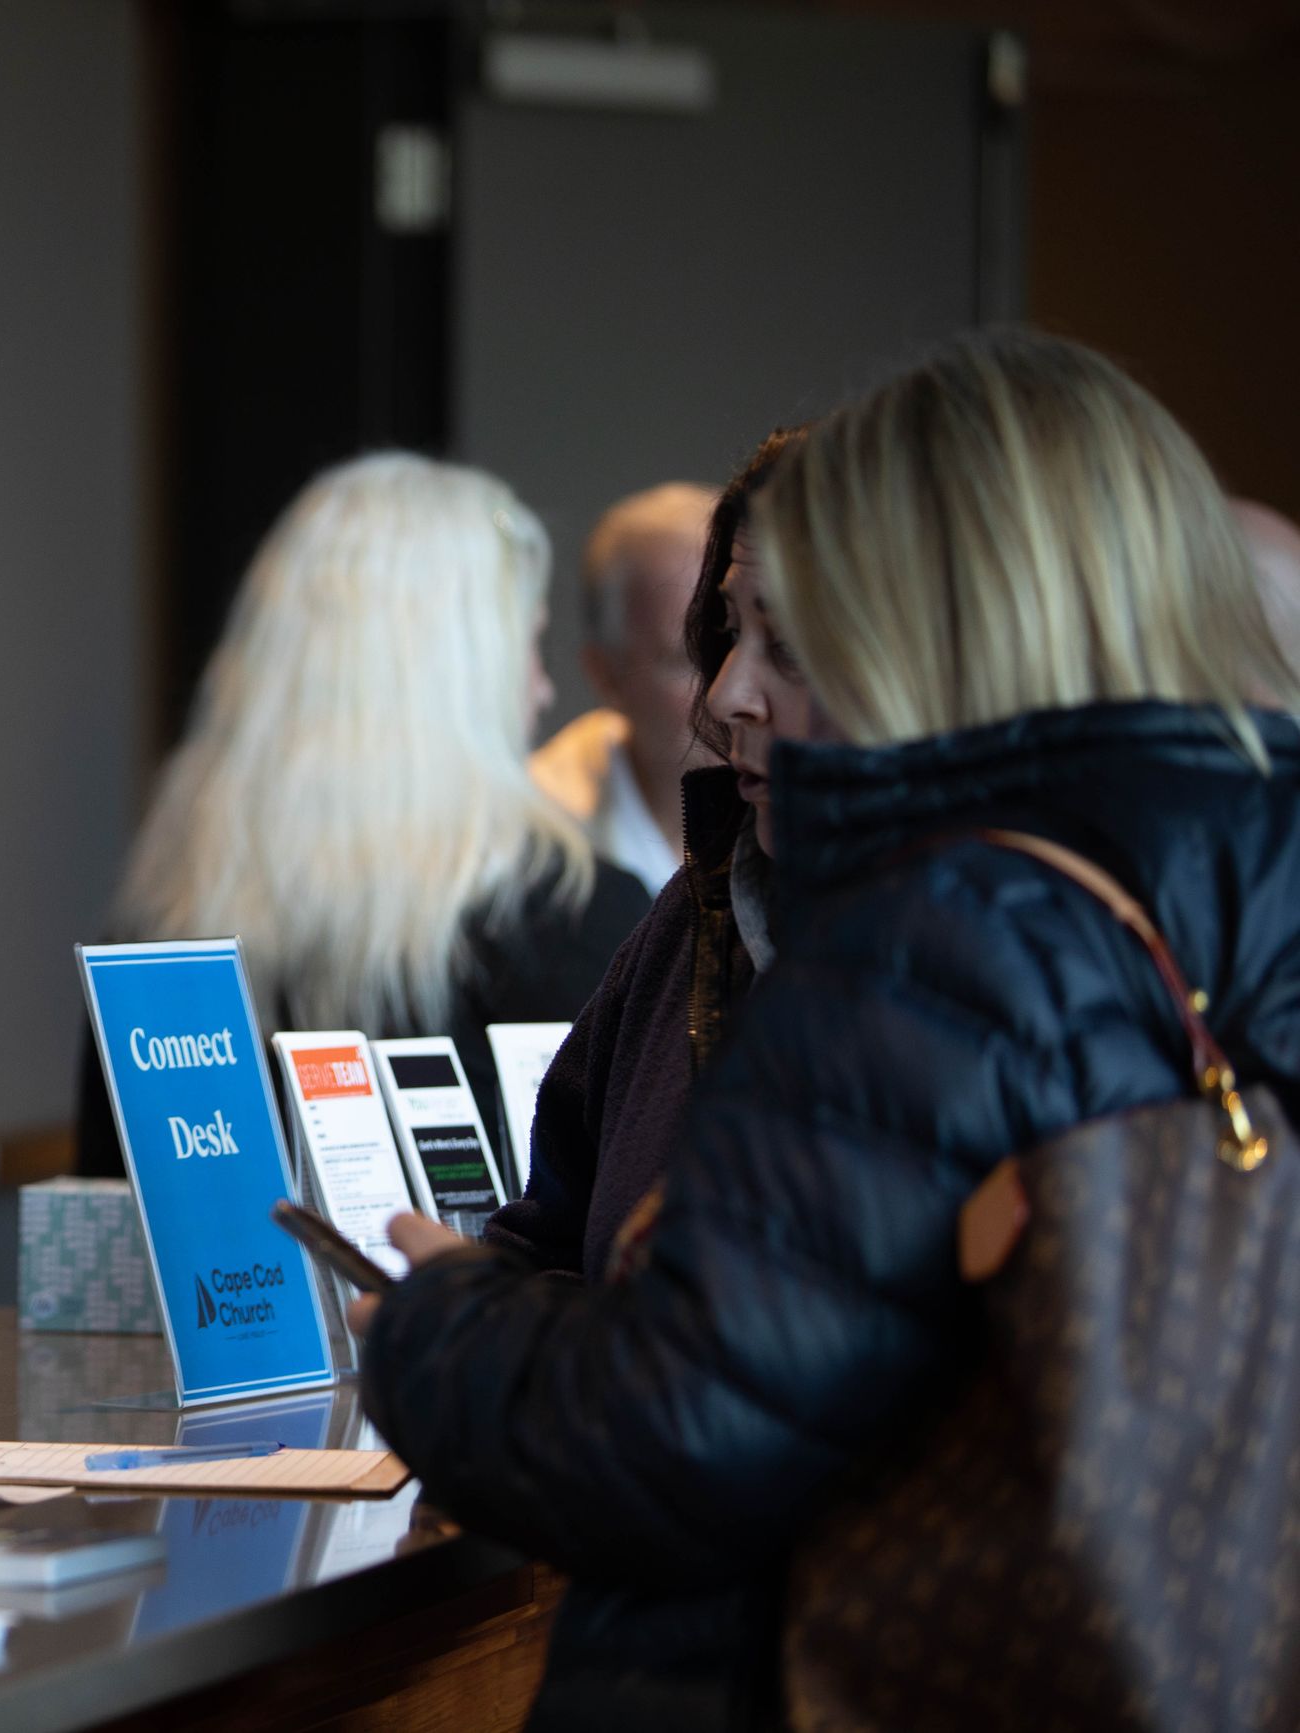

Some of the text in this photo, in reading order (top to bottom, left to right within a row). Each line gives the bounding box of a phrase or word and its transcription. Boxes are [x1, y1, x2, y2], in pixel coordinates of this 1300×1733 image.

[129, 1026, 238, 1072] Connect
[167, 1109, 240, 1160] Desk
[211, 1262, 285, 1298] Cape Cod
[219, 1298, 276, 1327] Church
